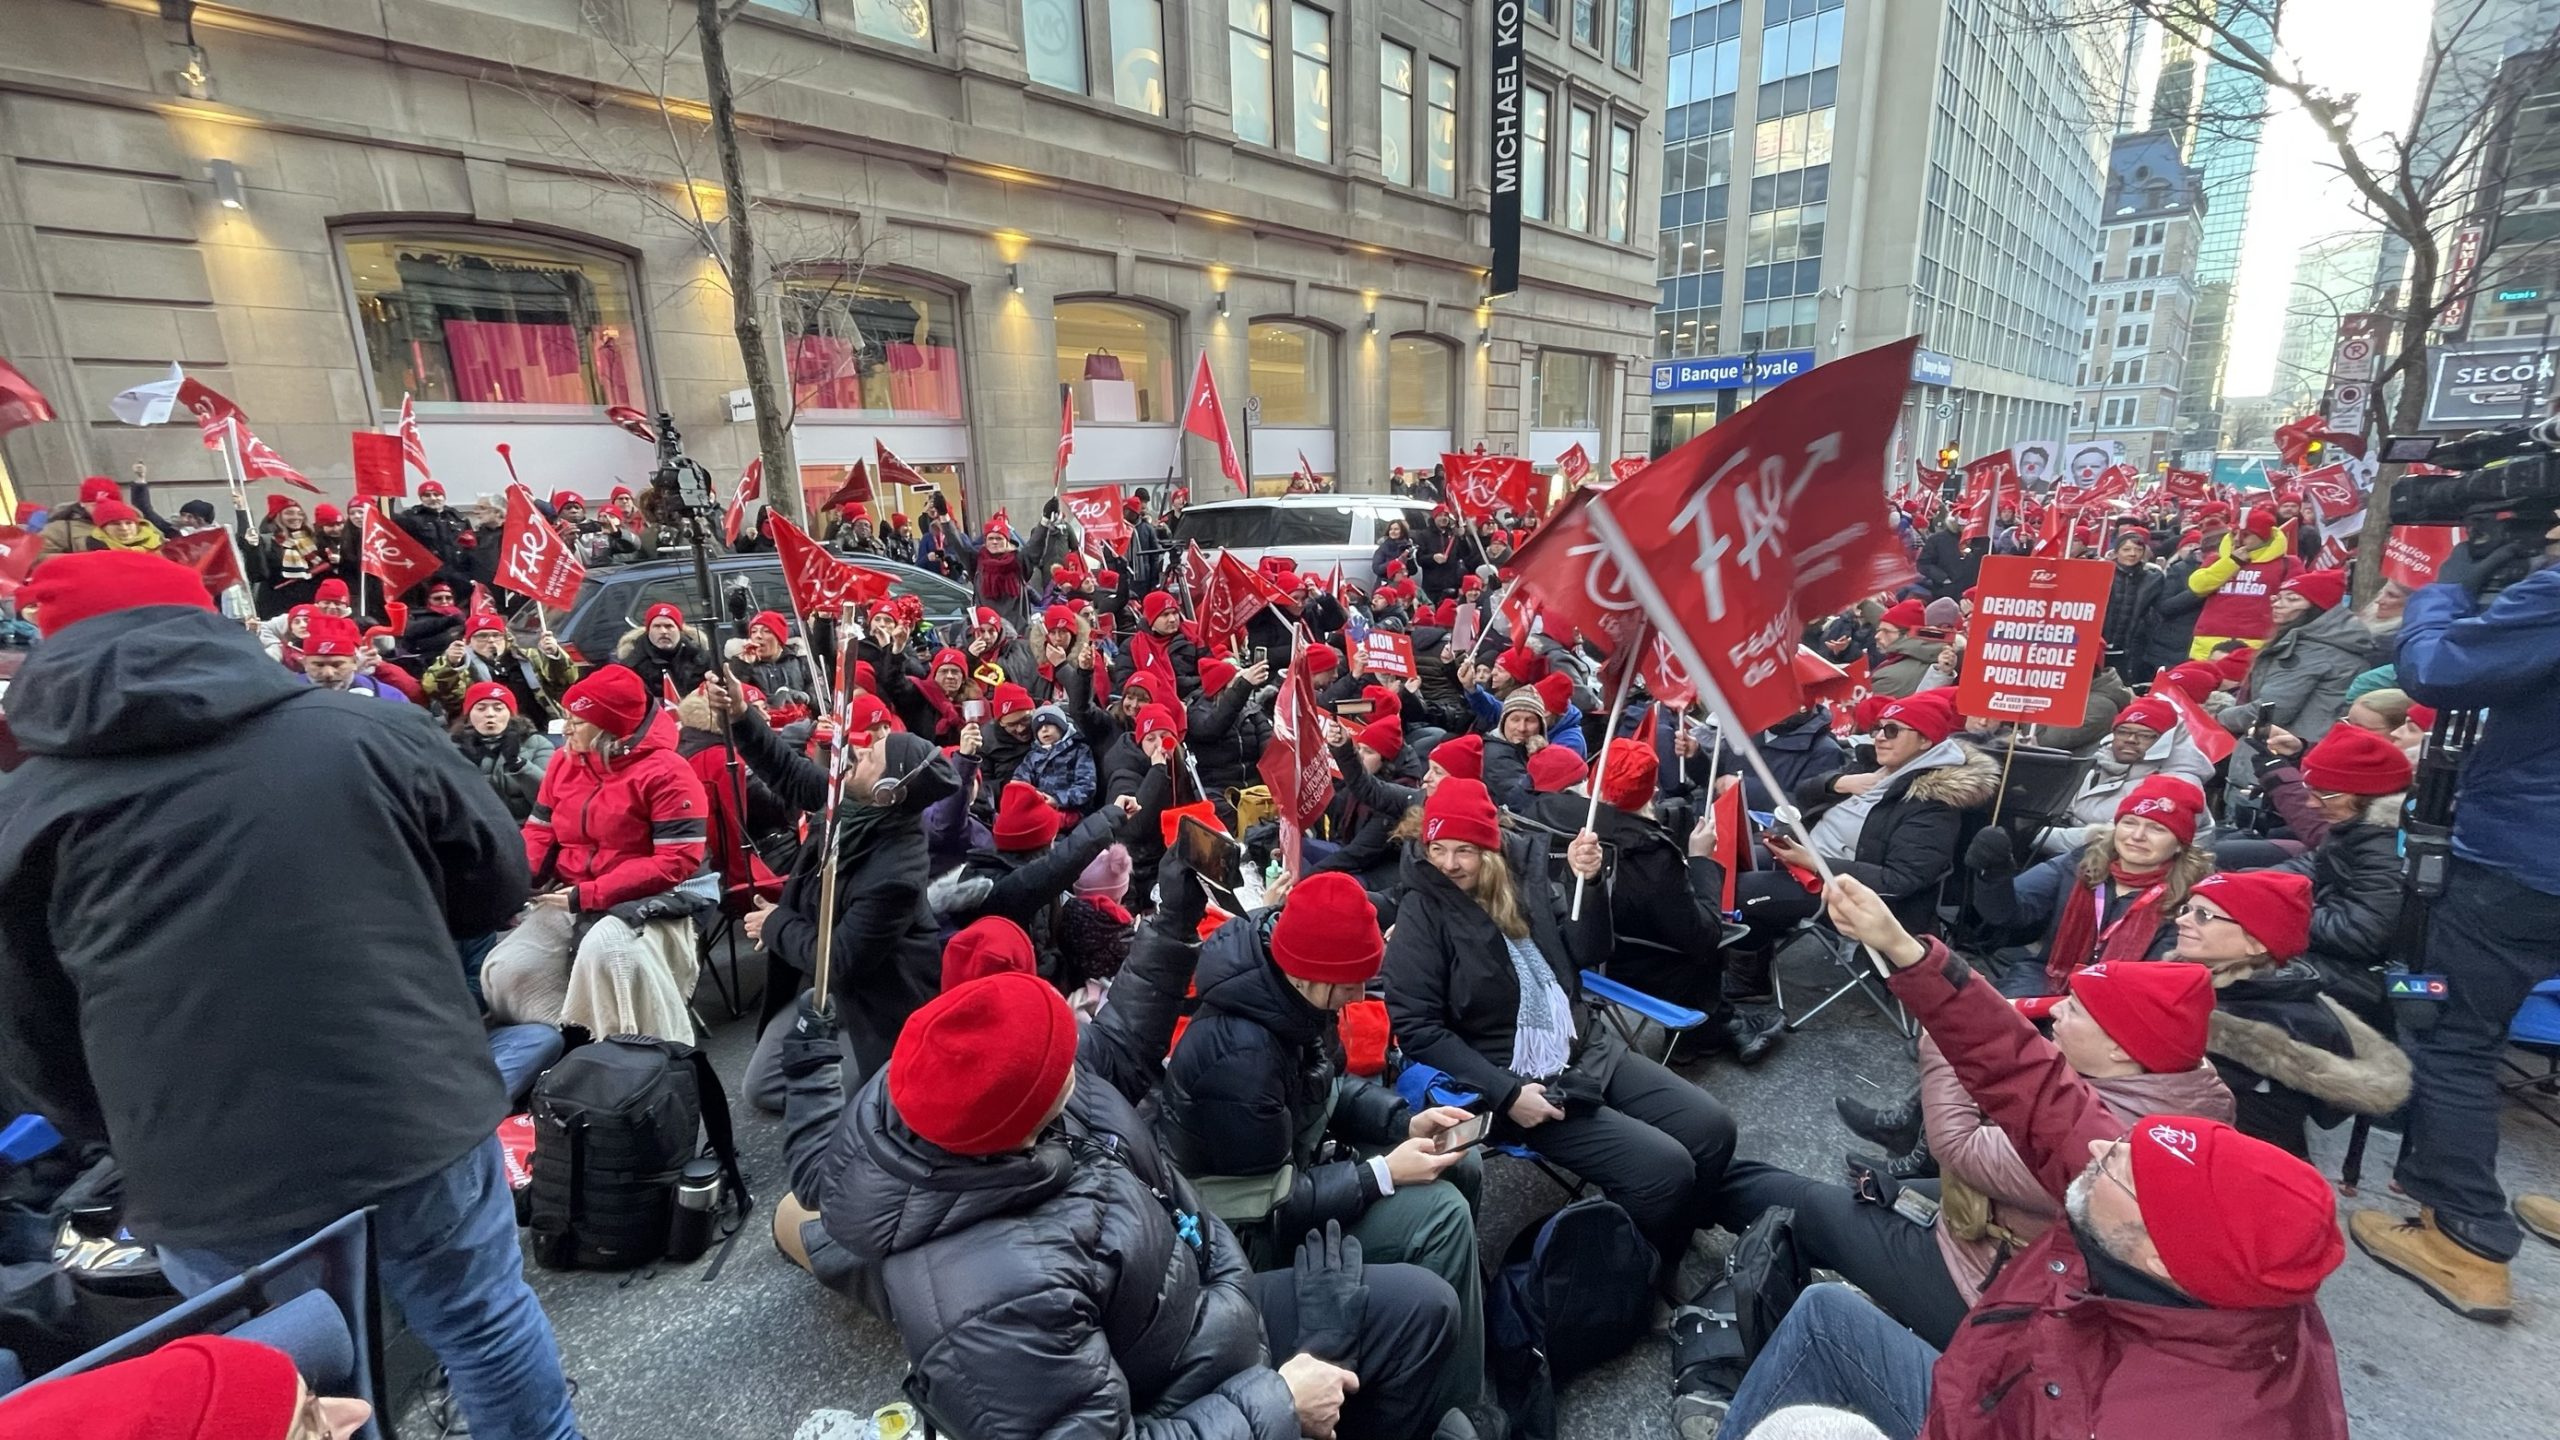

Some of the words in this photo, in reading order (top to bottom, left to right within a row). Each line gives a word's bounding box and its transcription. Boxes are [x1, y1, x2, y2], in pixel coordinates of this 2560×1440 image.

[1497, 0, 1518, 47] KO
[1496, 55, 1517, 194] MICHAEL
[1681, 366, 1738, 383] Banque
[1743, 358, 1798, 380] oyale
[2455, 363, 2552, 384] SECO
[2387, 535, 2431, 562] ération
[2236, 570, 2261, 581] ROF
[1982, 596, 2047, 618] DEHORS
[2050, 601, 2097, 621] POUR
[1369, 633, 1394, 651] NON
[1993, 619, 2075, 644] PROTÉGER
[1982, 643, 2023, 662] MON
[2027, 643, 2077, 667] ÉCOLE
[1743, 657, 1778, 688] de
[1983, 666, 2067, 689] PUBLIQUE!
